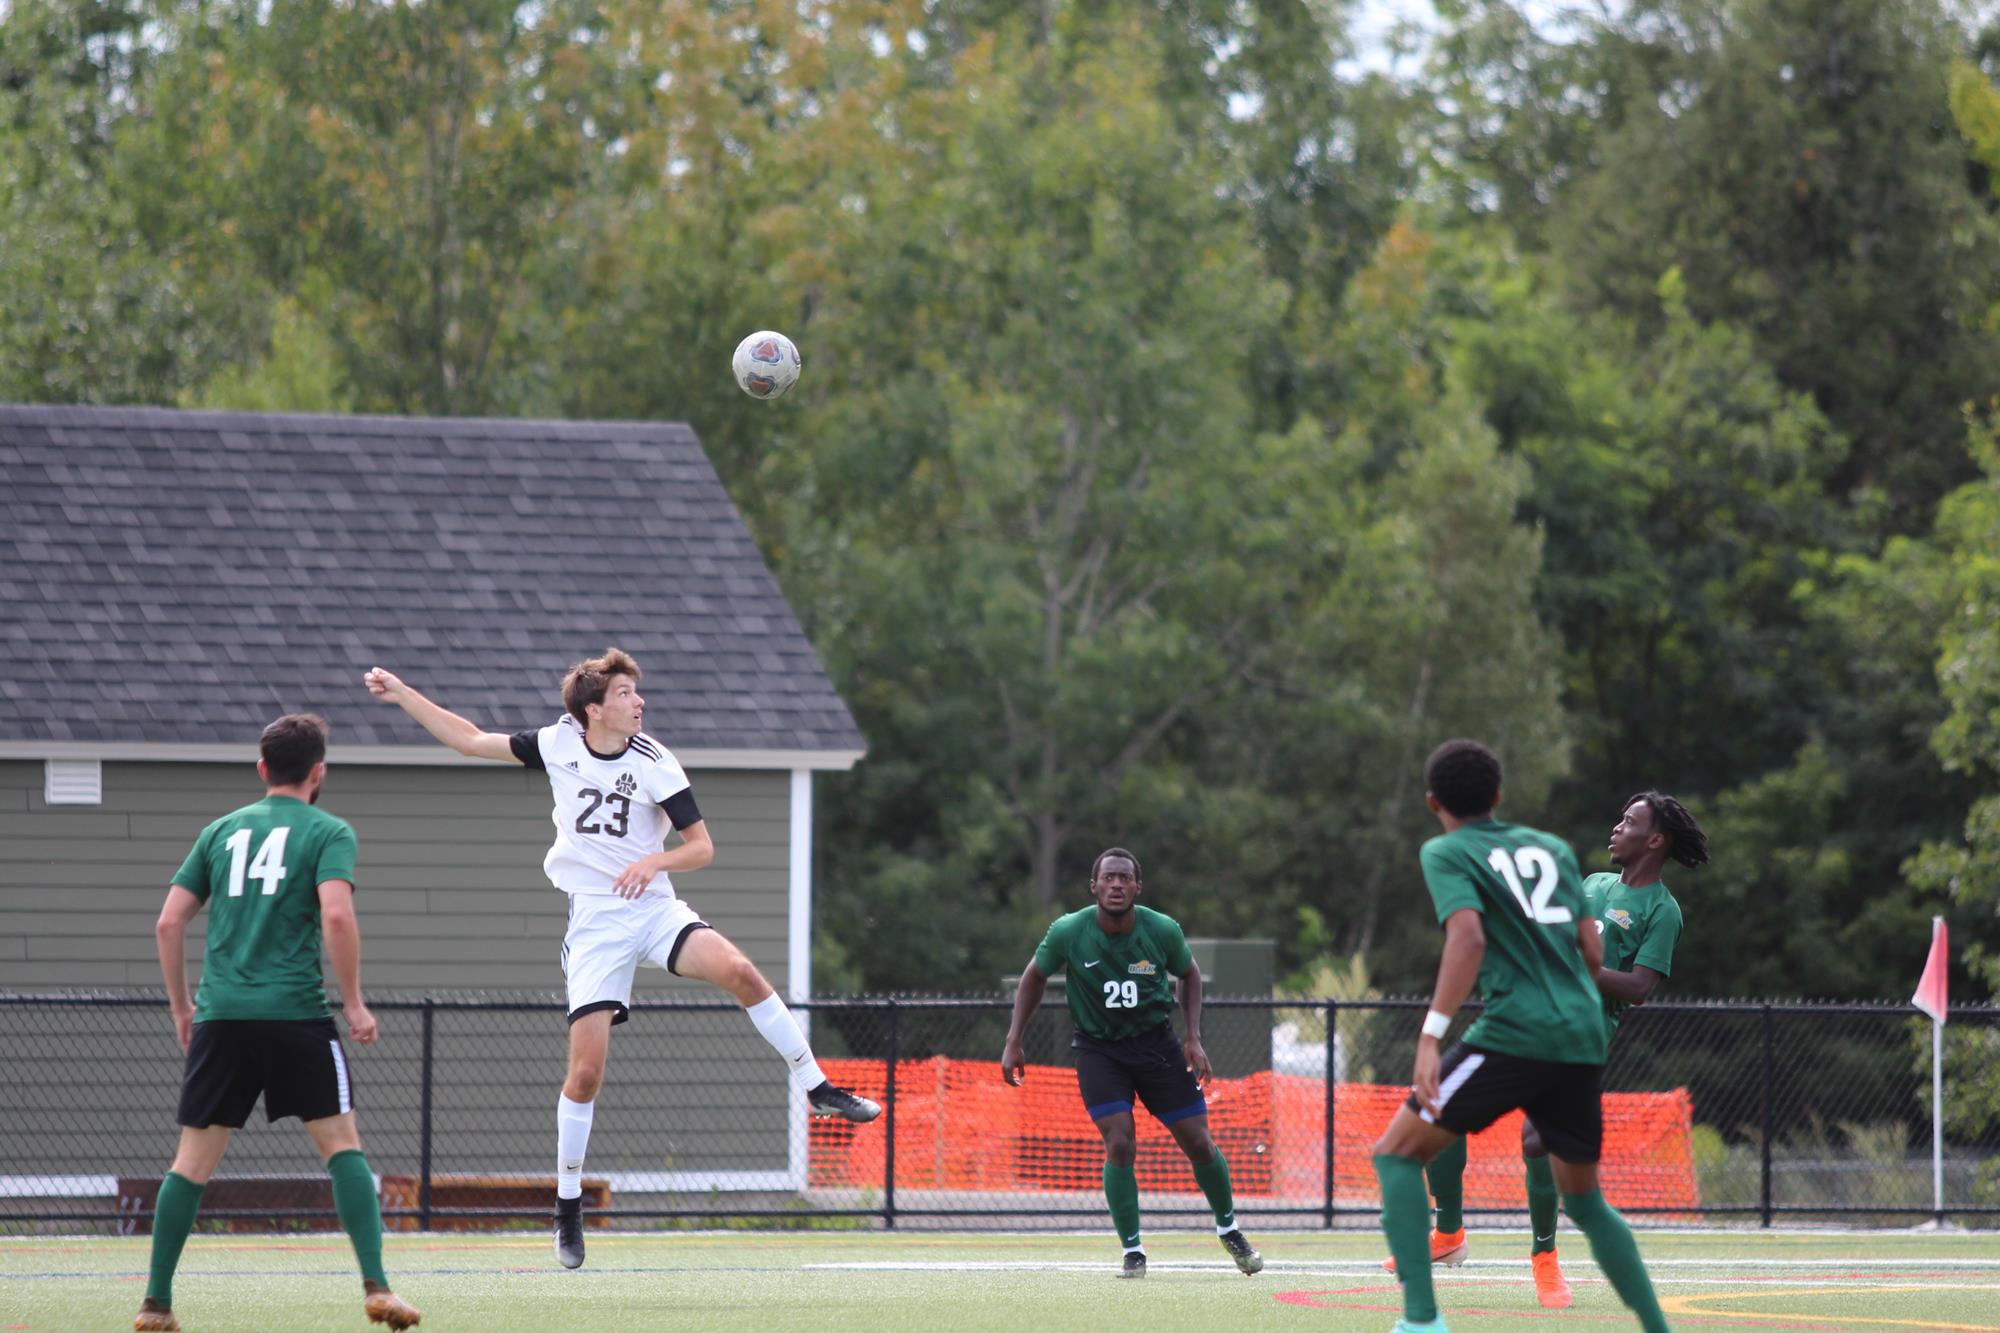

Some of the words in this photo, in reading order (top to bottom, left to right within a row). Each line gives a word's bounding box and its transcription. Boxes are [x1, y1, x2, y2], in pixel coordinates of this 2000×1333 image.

[576, 788, 630, 838] 23
[225, 826, 291, 897] 14
[1487, 846, 1573, 924] 12
[1103, 980, 1138, 1008] 29
